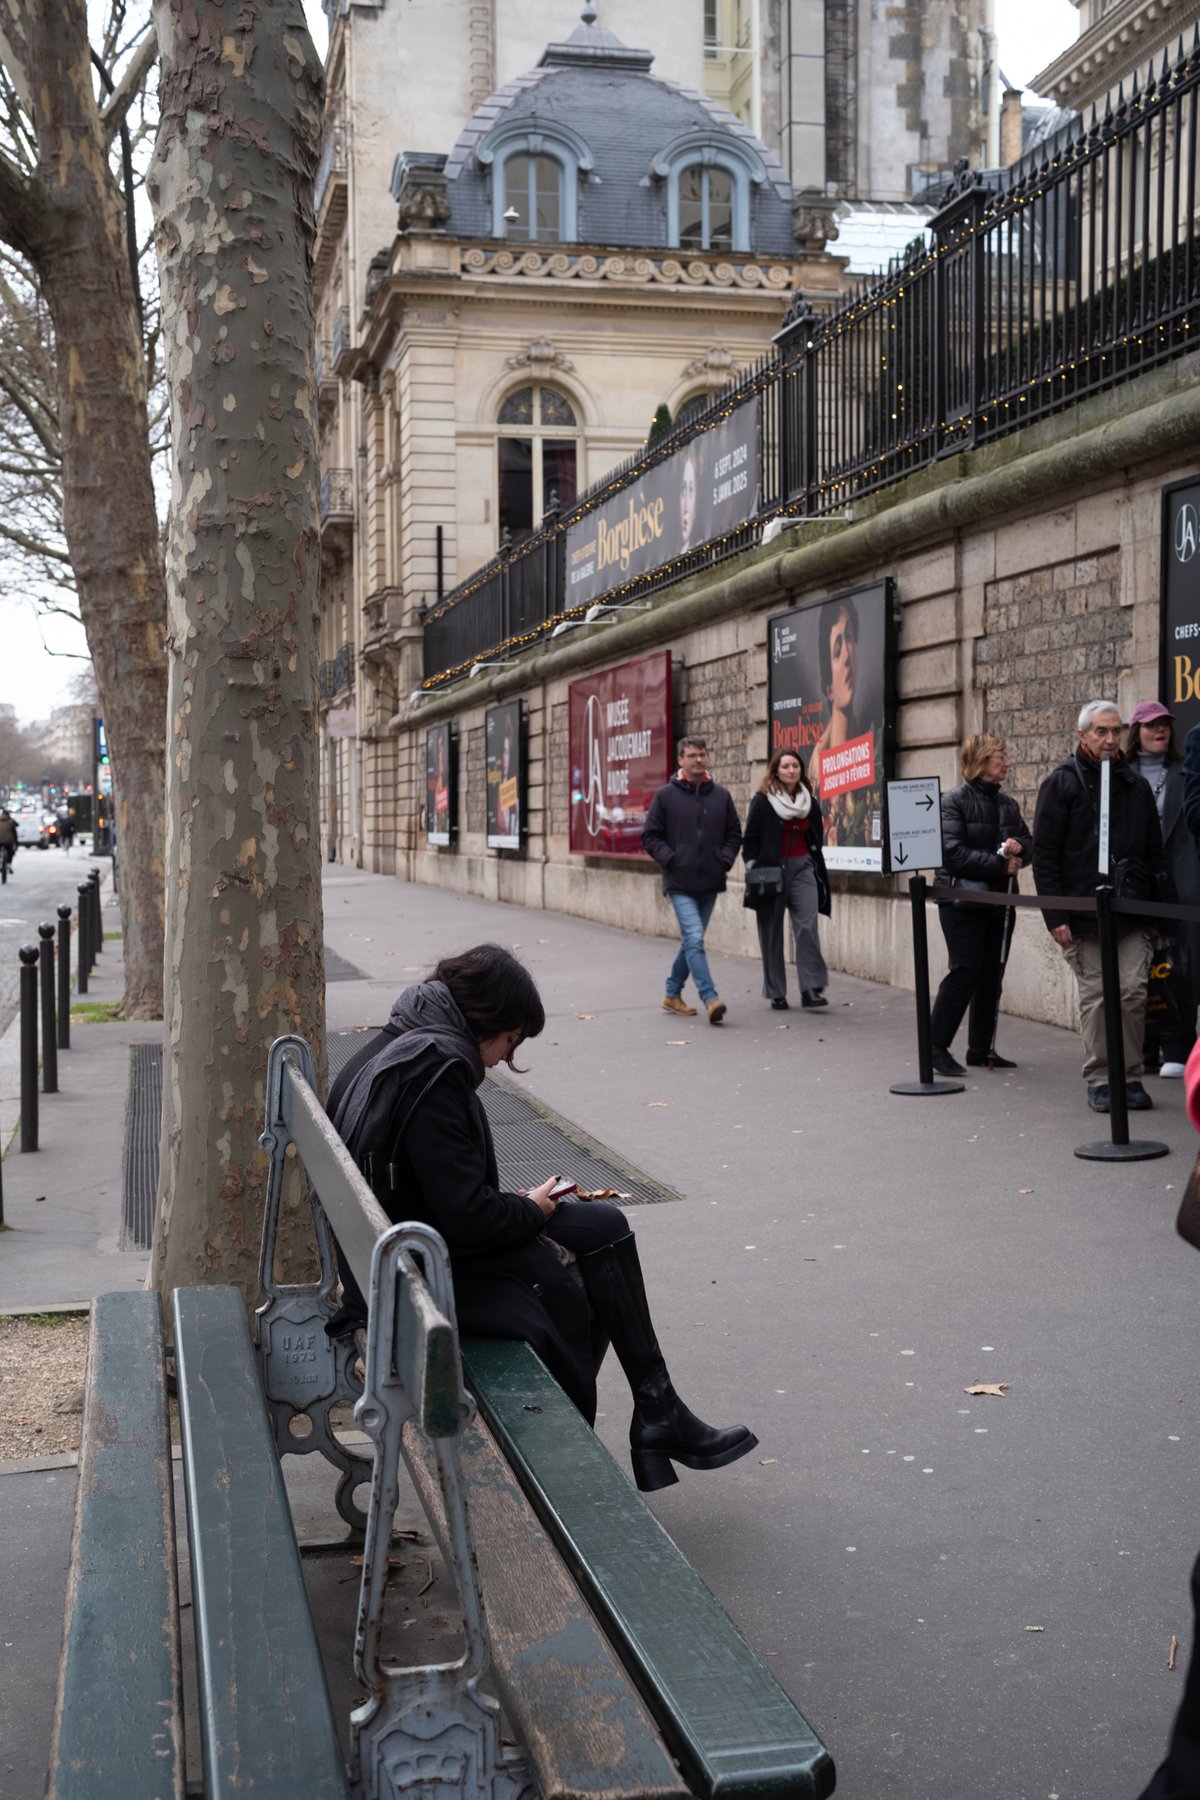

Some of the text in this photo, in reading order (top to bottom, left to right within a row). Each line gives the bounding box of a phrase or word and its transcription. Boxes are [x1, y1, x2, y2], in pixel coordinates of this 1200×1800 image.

[733, 444, 747, 467] 2024
[713, 487, 718, 505] 5
[733, 470, 748, 494] 2025
[597, 490, 664, 571] Borghèse
[606, 693, 630, 728] MUSÉE
[607, 730, 652, 762] JACQUEMART
[773, 714, 824, 752] Borghèse
[822, 741, 870, 775] PROLONGATIONS
[845, 769, 850, 783] 9
[850, 762, 870, 782] FÉVRIER
[606, 762, 630, 796] ANDRÉ
[283, 1335, 316, 1351] UAF
[285, 1351, 317, 1365] 1973
